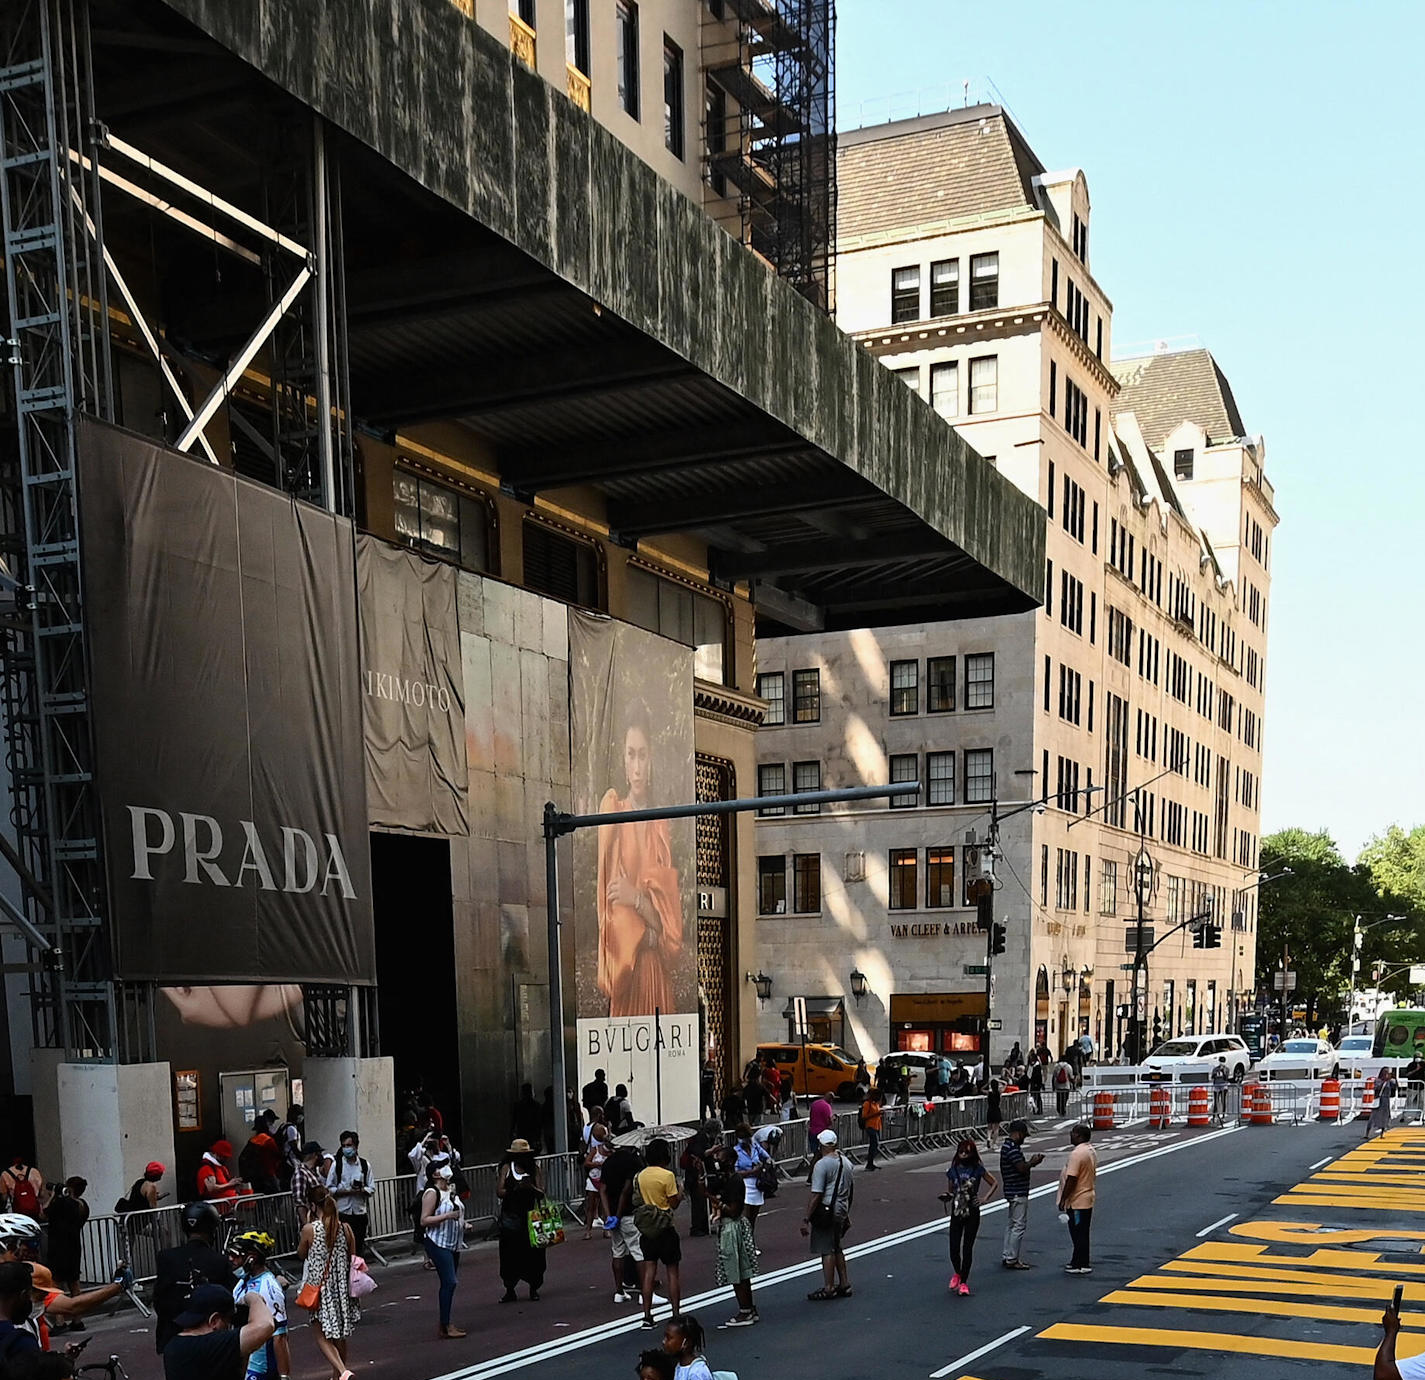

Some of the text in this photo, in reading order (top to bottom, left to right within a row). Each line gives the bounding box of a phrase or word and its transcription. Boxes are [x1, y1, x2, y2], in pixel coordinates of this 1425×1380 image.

[367, 670, 451, 712] IKIMOTO
[126, 804, 357, 900] PRADA
[891, 923, 908, 937] VAN
[911, 922, 941, 937] CLEEF
[943, 922, 950, 935] &
[588, 1023, 692, 1056] BVLGARI
[668, 1049, 686, 1058] ROMA
